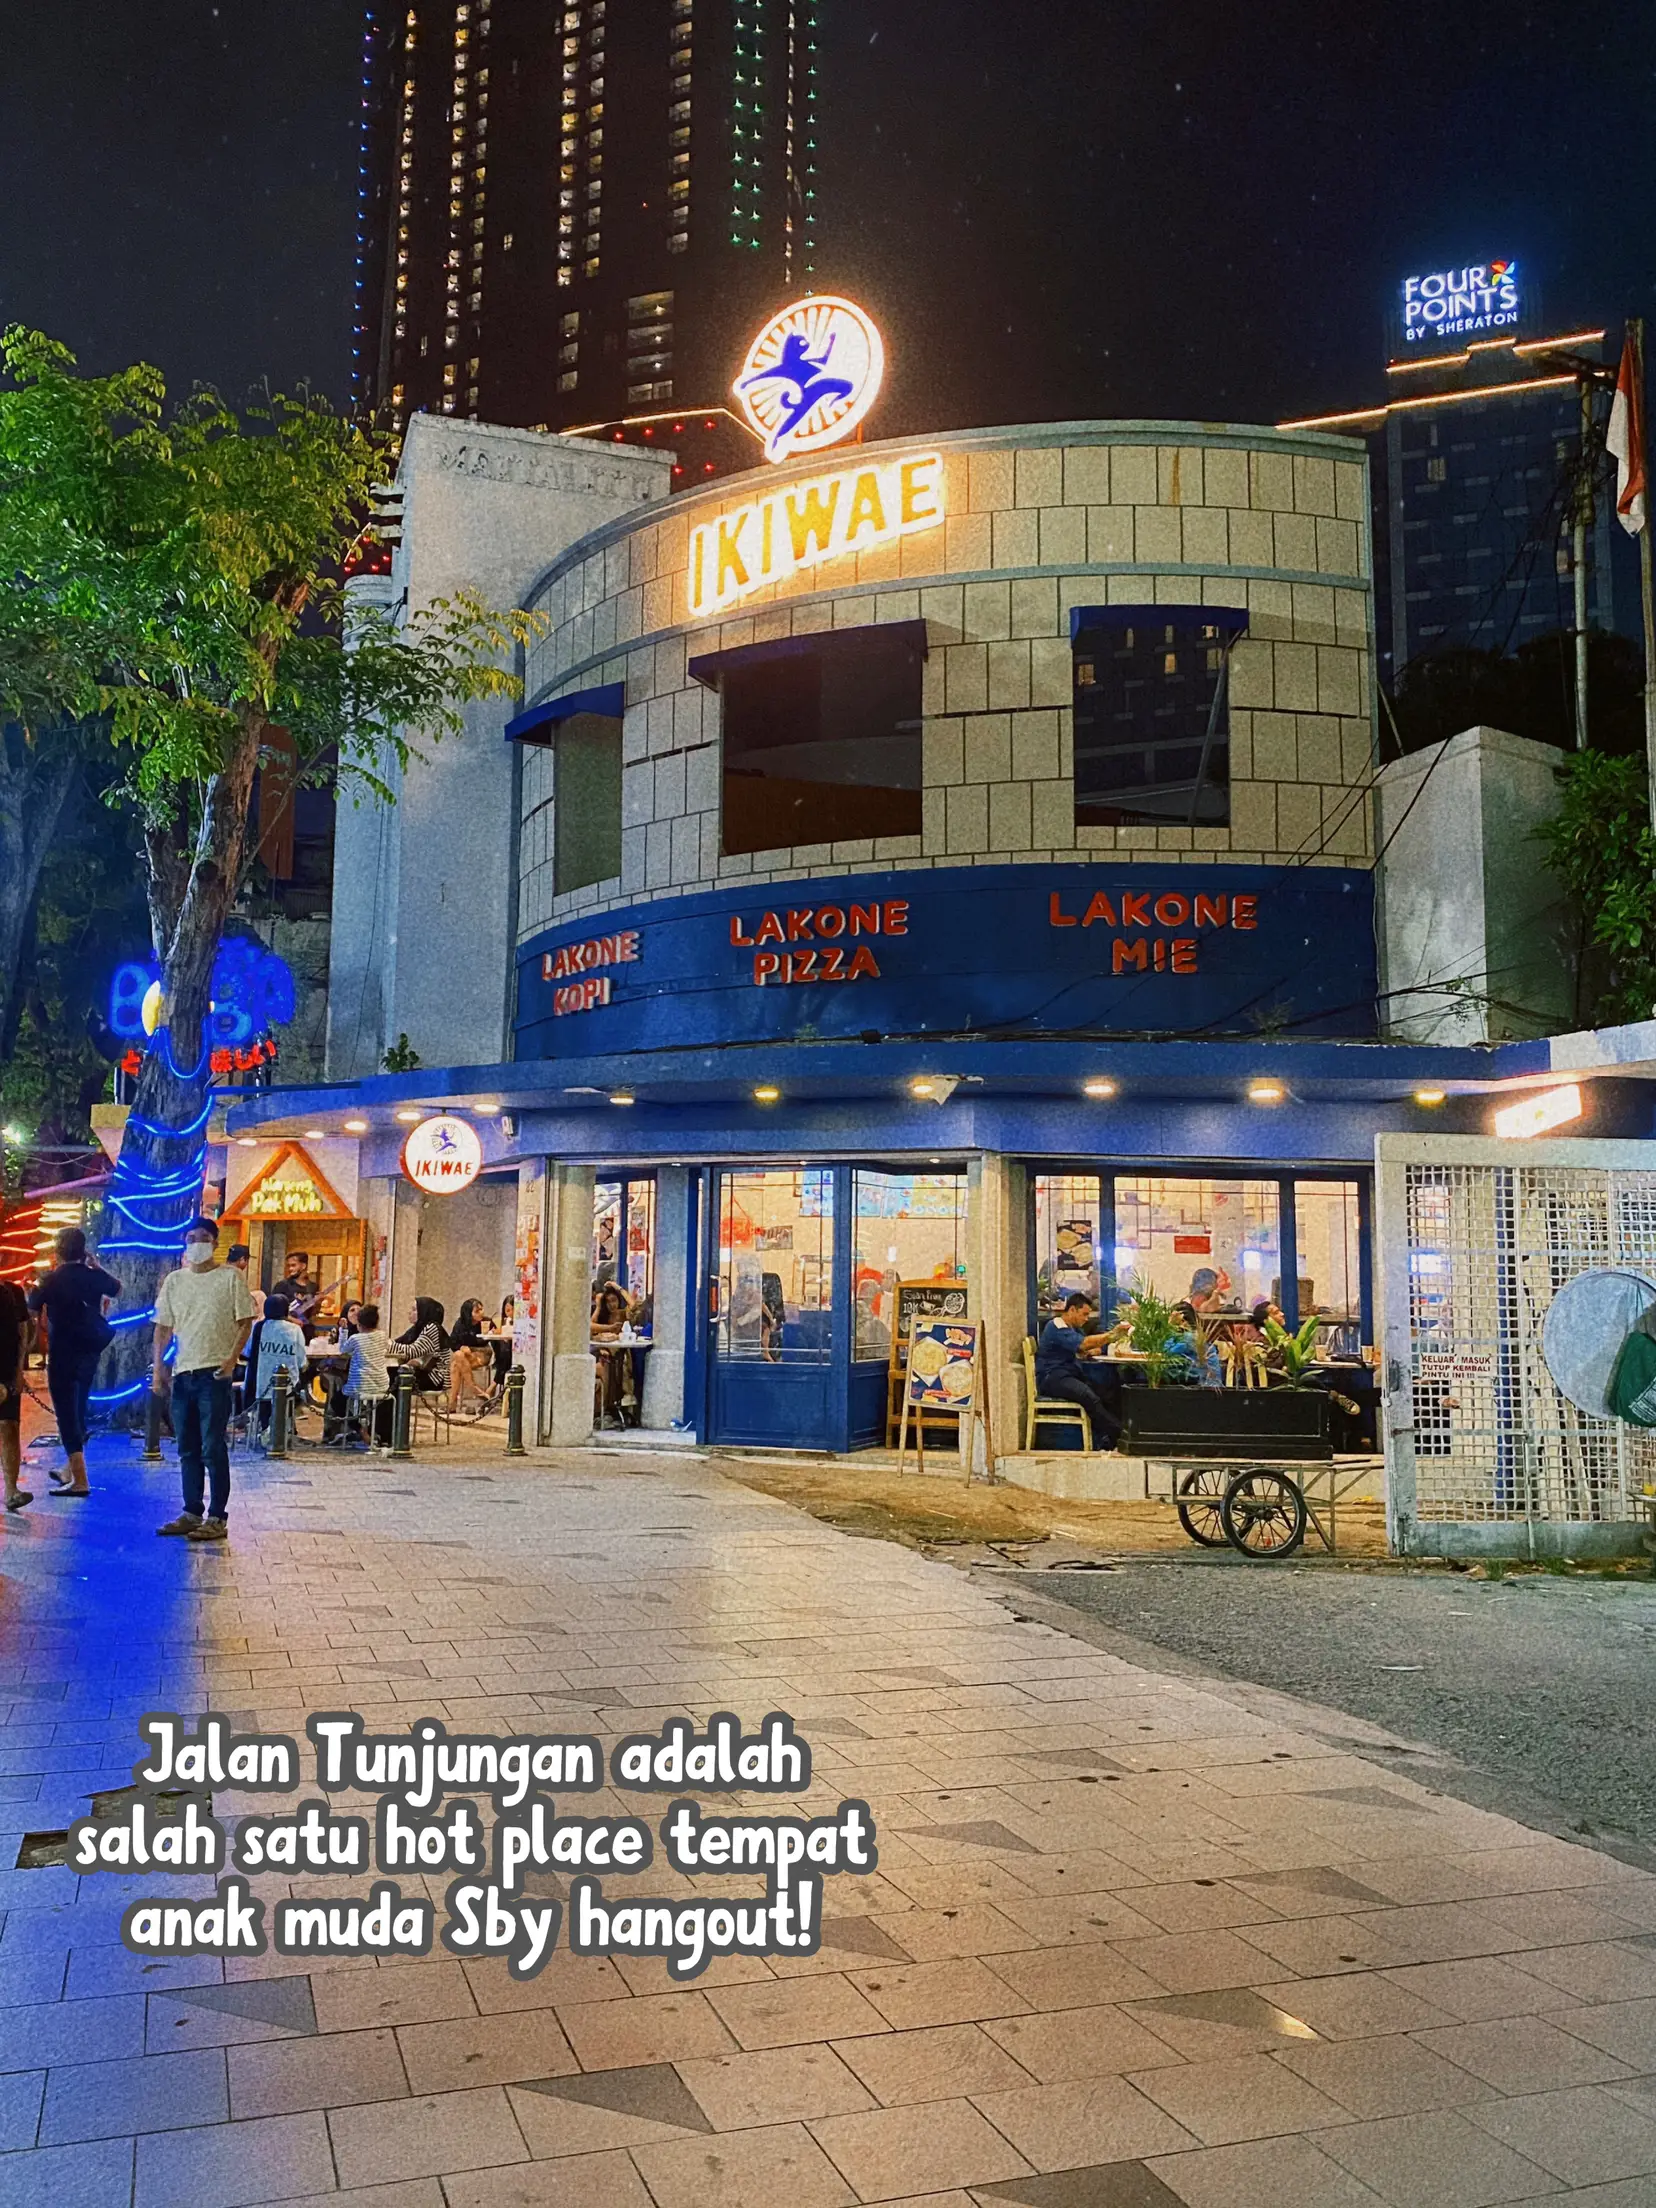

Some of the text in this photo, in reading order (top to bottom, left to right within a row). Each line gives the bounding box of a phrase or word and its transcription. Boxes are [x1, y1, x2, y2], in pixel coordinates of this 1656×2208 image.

[1405, 267, 1488, 302] FOUR
[1405, 284, 1517, 326] POINTS
[1406, 311, 1518, 341] BY SHERATON
[690, 455, 941, 613] IKIWAE
[729, 899, 909, 946] LAKONE
[1050, 891, 1258, 930] LAKONE
[542, 930, 640, 981] LAKONE
[754, 945, 881, 986] PIZZA
[1112, 937, 1198, 975] MIE
[553, 977, 610, 1017] KOPI
[415, 1160, 474, 1177] IKIWAE
[260, 1341, 296, 1356] VIVAL
[1422, 1355, 1454, 1364] KELUAR
[1461, 1356, 1491, 1365] MASUK
